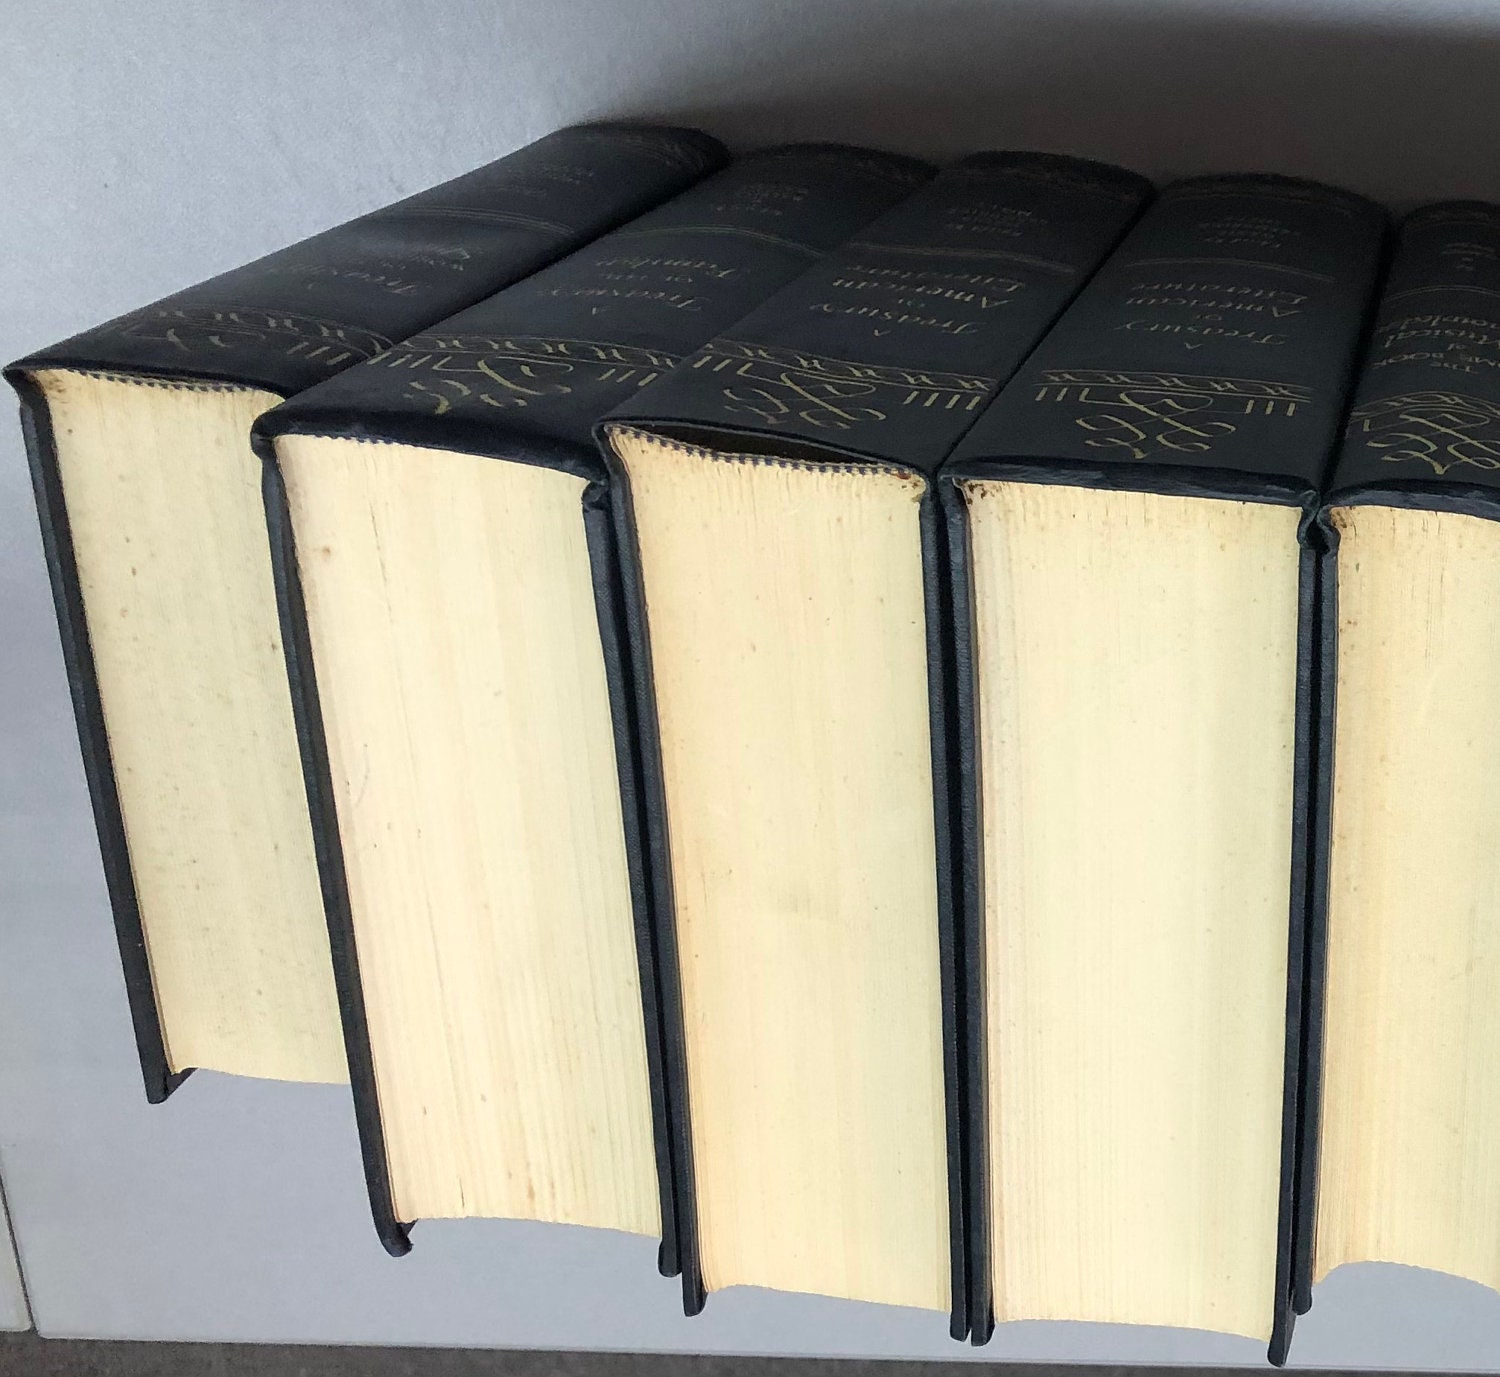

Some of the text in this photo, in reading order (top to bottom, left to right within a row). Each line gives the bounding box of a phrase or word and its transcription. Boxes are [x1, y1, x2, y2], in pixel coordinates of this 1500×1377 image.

[846, 265, 1025, 292] Literature
[831, 278, 1014, 309] American
[1132, 282, 1308, 305] Literature
[808, 303, 987, 335] Treasury
[1126, 298, 1303, 318] American
[1112, 320, 1289, 345] Treasury
